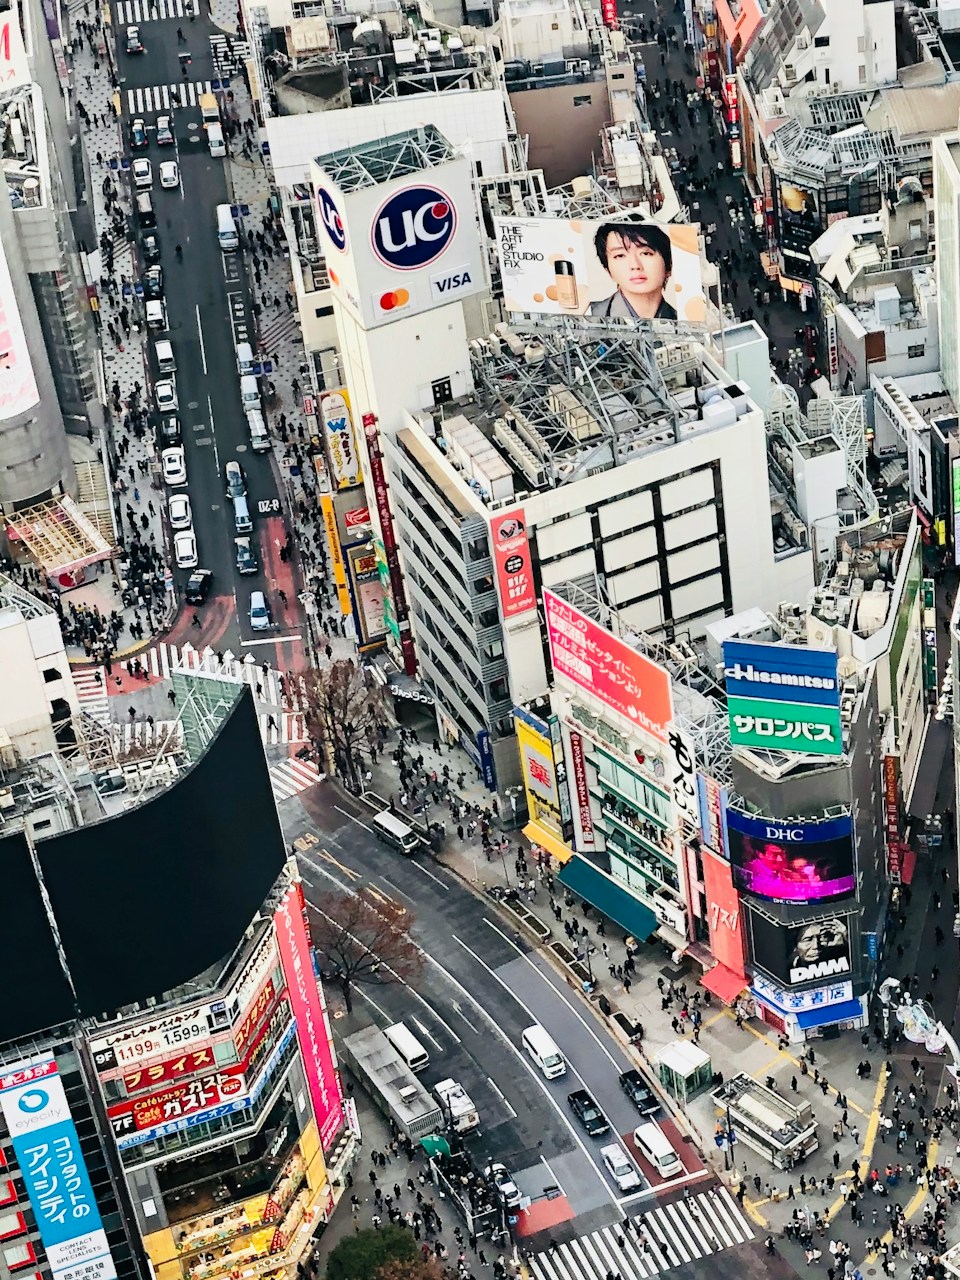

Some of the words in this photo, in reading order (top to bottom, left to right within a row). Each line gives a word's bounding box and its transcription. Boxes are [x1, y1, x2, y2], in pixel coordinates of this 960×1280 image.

[379, 200, 449, 252] UC
[502, 226, 522, 234] THE
[501, 235, 523, 243] ART
[502, 243, 516, 251] OF
[503, 251, 545, 262] STUDIO
[504, 260, 521, 268] FIX
[435, 272, 472, 292] VISA
[549, 598, 588, 632] わたしの
[551, 631, 643, 698] イルミネーションより
[724, 663, 834, 690] Hisamitsu
[638, 709, 669, 739] tinde
[733, 714, 834, 742] サロンパス
[766, 826, 804, 841] DHC
[790, 957, 849, 983] DMM
[95, 1053, 113, 1064] 9F
[125, 1050, 211, 1088] プライス
[188, 1073, 229, 1094] ガスト
[223, 1082, 241, 1092] ガスト
[164, 1093, 214, 1118] ガスト
[16, 1108, 61, 1128] eyecity
[113, 1116, 133, 1130] 7F
[23, 1142, 67, 1224] アイシティ
[53, 1136, 90, 1218] コンタクトの
[57, 1245, 102, 1264] SPECIALISTS
[60, 1237, 93, 1252] CONTACT
[69, 1245, 87, 1254] LENS
